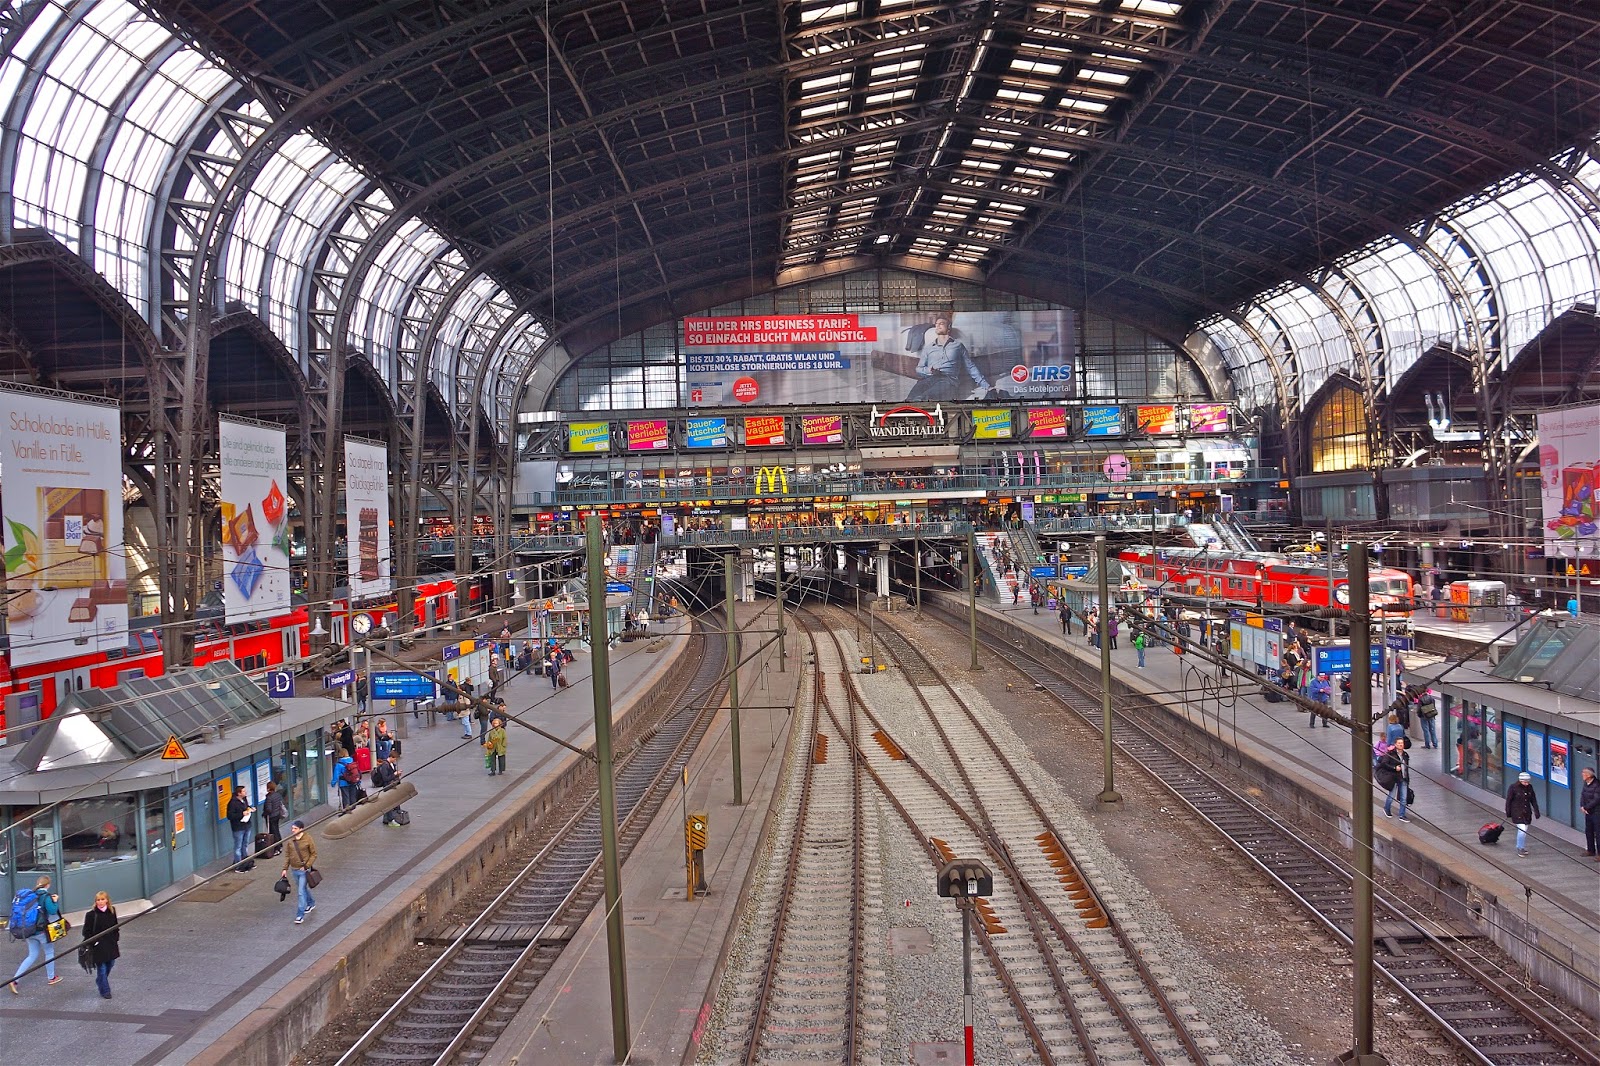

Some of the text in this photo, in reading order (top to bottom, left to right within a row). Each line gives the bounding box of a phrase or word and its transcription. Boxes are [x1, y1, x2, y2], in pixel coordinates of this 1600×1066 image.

[688, 318, 851, 332] NEU! DER HRS BUSINESS TARIF:
[688, 328, 867, 344] SO EINFACH BUCHT MAN GÜNSTIG.
[765, 354, 792, 362] GRATIS
[794, 353, 817, 361] WLAN
[818, 353, 835, 361] UND
[689, 361, 843, 372] KOSTENLOSE STORNIERUNG BIS 18 UHR.
[1031, 365, 1071, 381] HRS
[1013, 384, 1071, 394] Das Hotelportal
[1028, 409, 1054, 419] Frisch
[1083, 408, 1110, 418] Dauer-
[1138, 406, 1169, 417] Esstra-
[745, 417, 778, 429] Esstra-
[802, 414, 841, 427] Sonntags-
[972, 411, 1010, 425] Frühreif?
[10, 411, 113, 443] Schokolade in Hülle,
[628, 421, 655, 432] Frisch
[687, 419, 715, 430] Dauer-
[688, 424, 726, 437] lutscher?
[746, 421, 784, 435] vagant?
[803, 423, 832, 434] fahrer?
[569, 424, 609, 438] Frühreif?
[629, 426, 668, 439] verliebt?
[869, 426, 945, 437] WANDELHALLE
[11, 440, 85, 463] Vanille in Fülle.
[349, 453, 385, 473] So stapelt man
[66, 532, 81, 540] SPORT
[213, 648, 226, 658] REGIO
[1319, 651, 1328, 659] 8b
[276, 672, 290, 692] D
